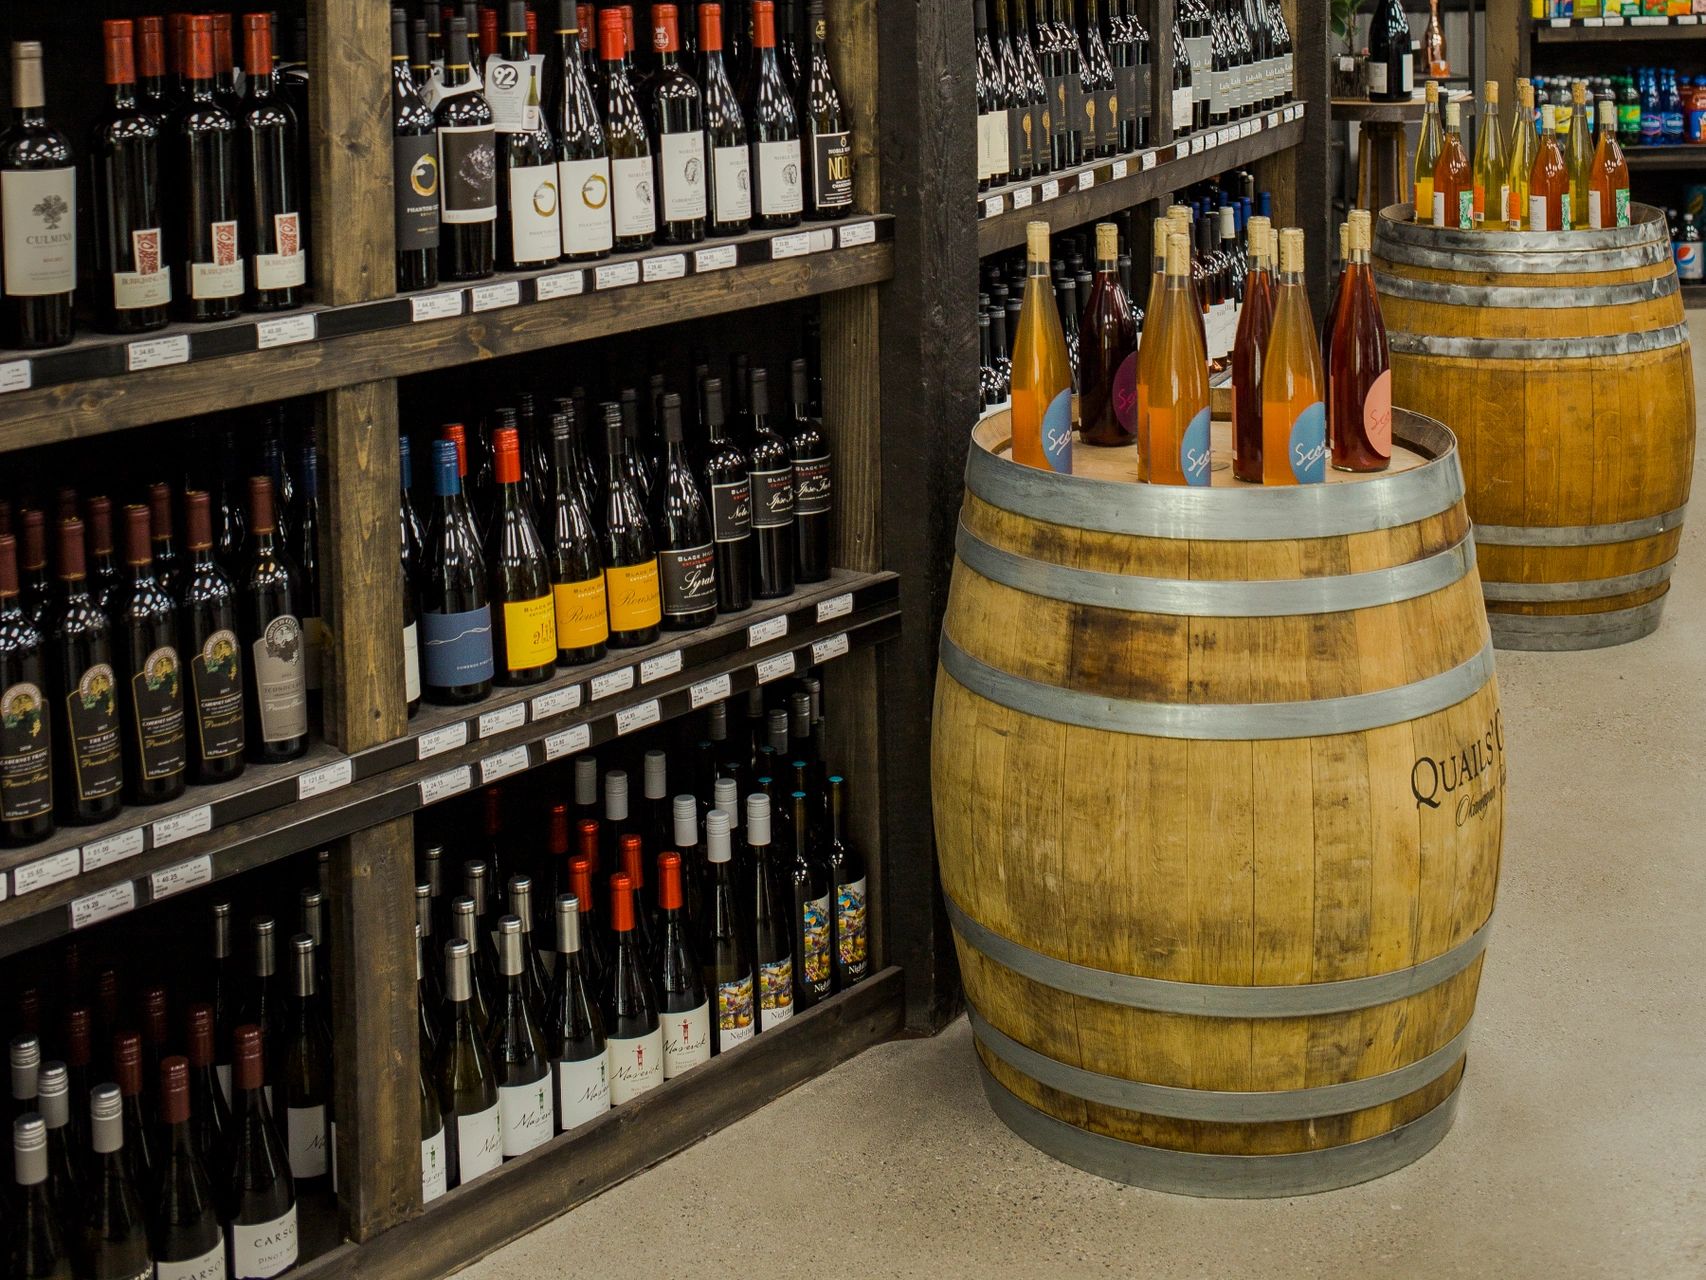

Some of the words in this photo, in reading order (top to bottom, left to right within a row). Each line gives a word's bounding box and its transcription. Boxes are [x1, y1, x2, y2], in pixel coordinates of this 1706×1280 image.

[496, 65, 517, 86] 92
[680, 568, 715, 597] Syrah
[611, 1058, 660, 1080] Maverick
[254, 1223, 297, 1248] CARSO
